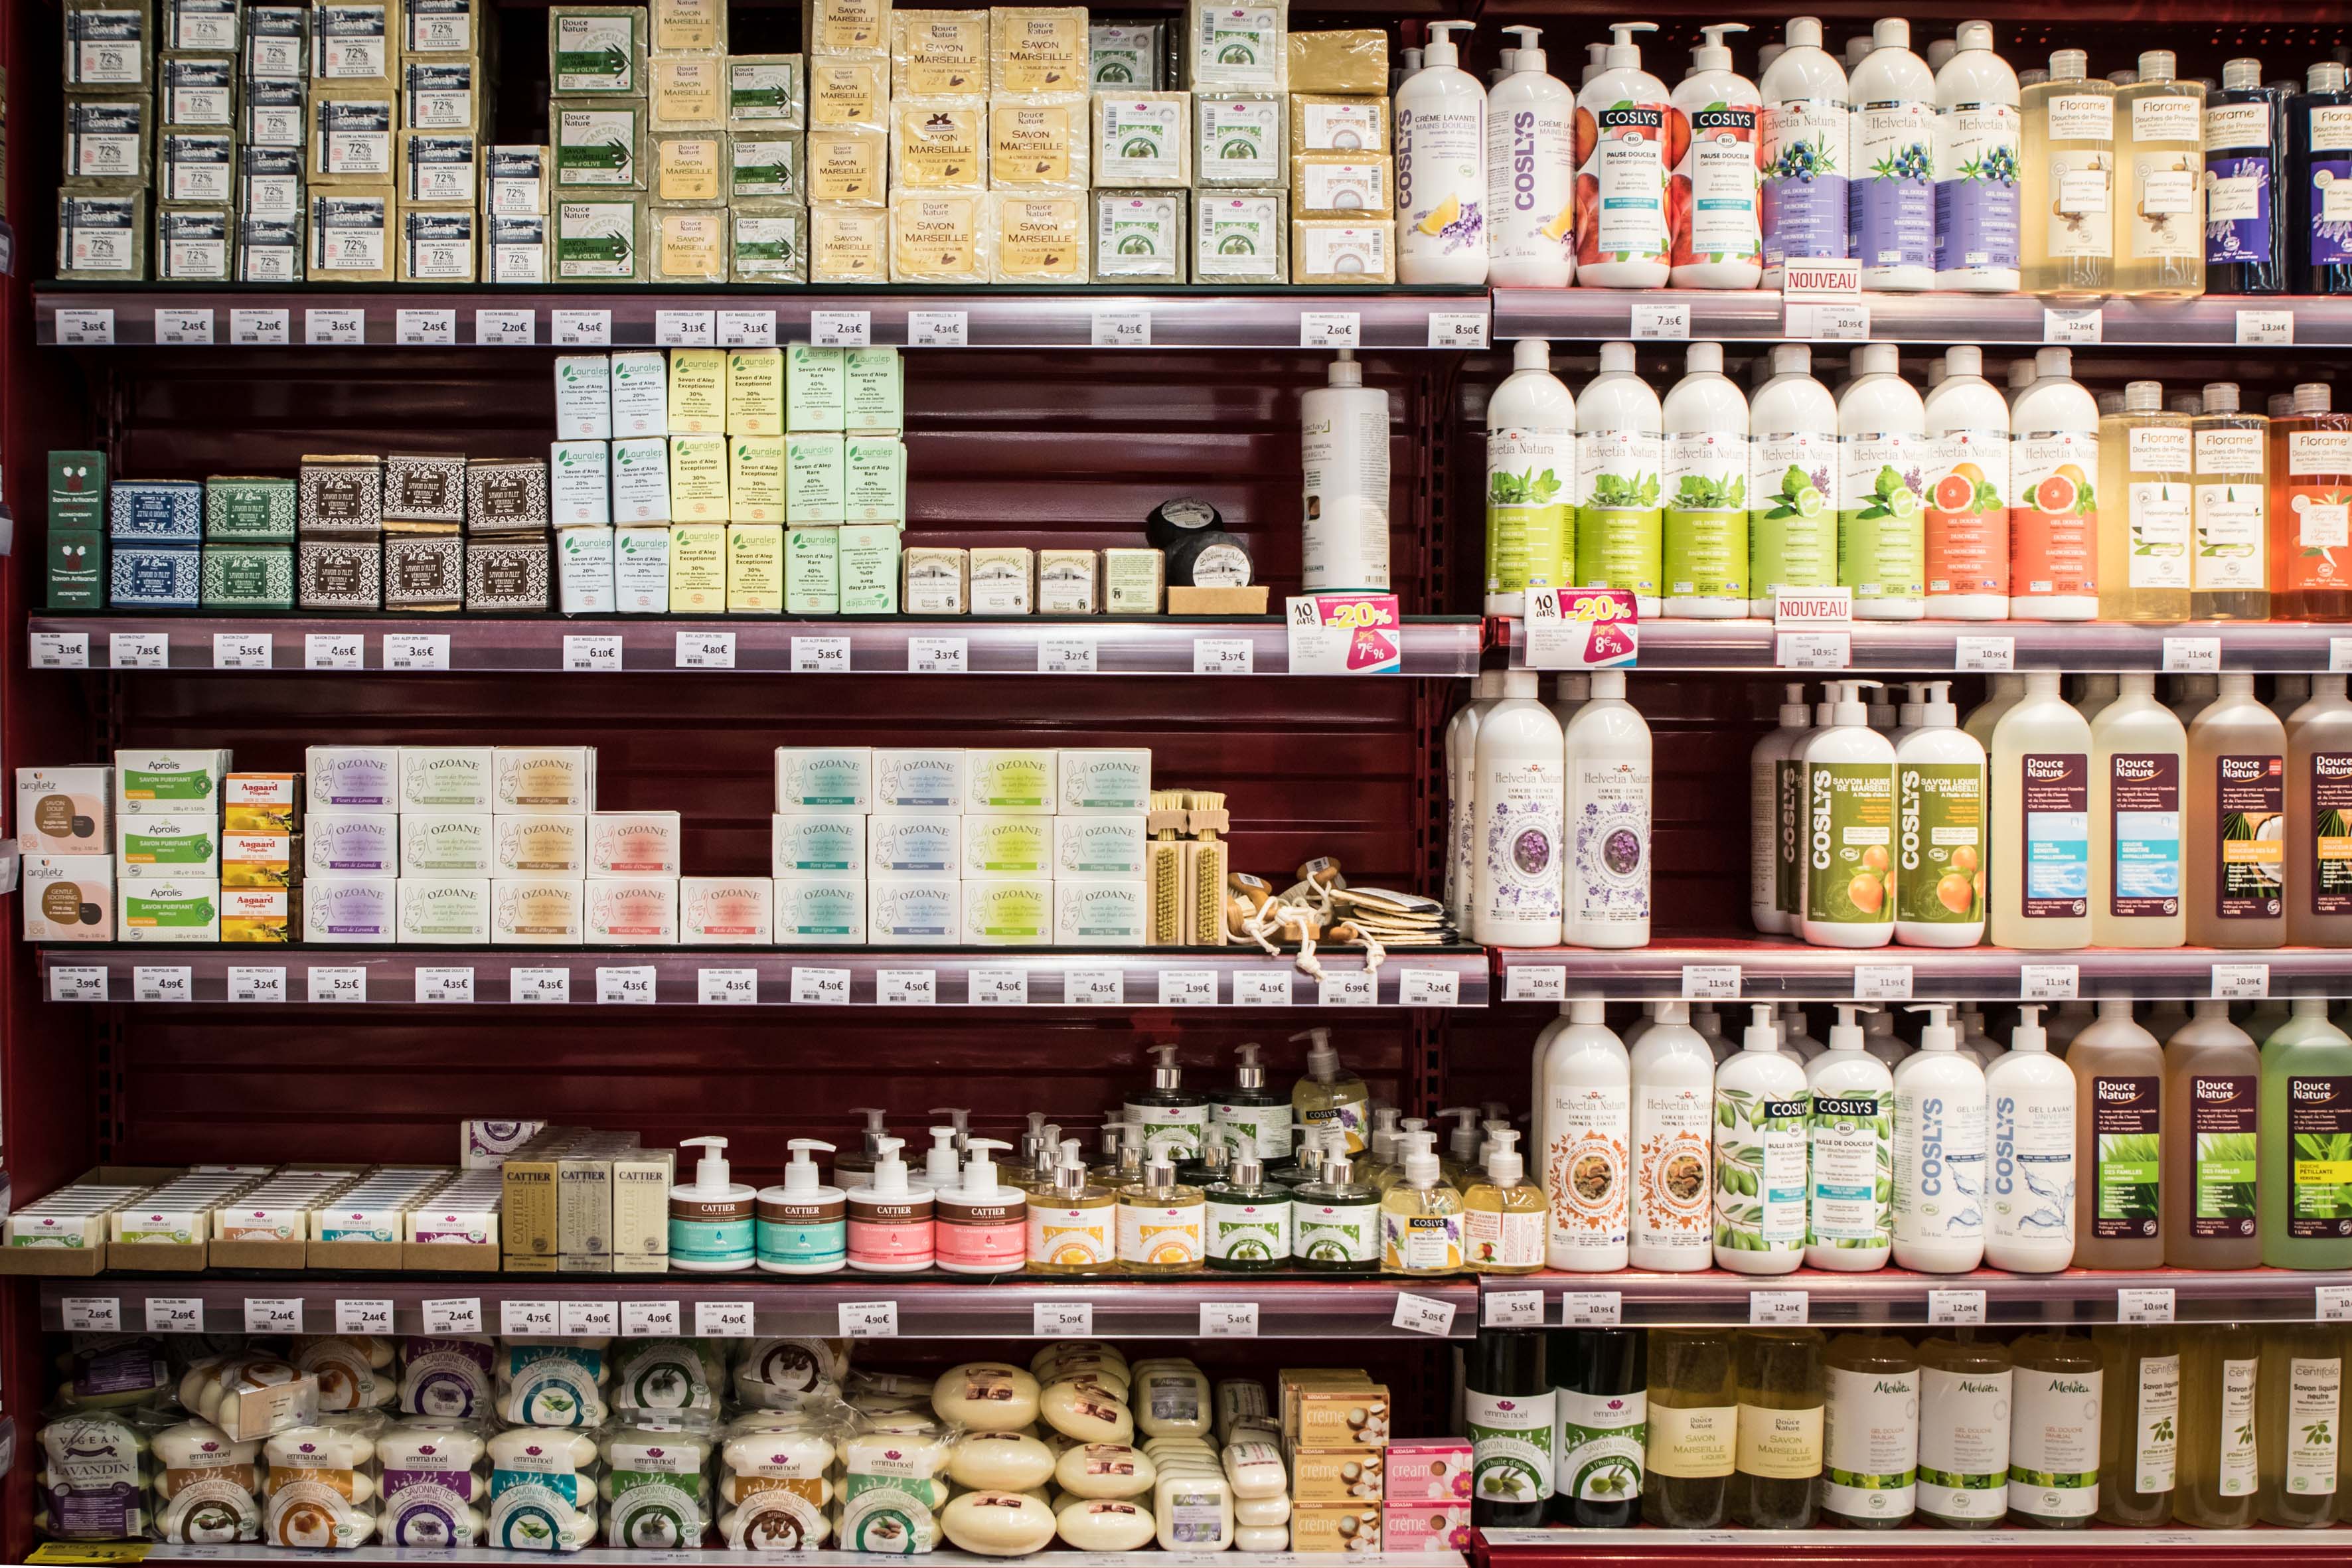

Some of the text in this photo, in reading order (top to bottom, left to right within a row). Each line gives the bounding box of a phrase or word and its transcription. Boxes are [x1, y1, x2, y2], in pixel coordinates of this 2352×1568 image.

[914, 55, 977, 64] MARSEILLE
[1010, 52, 1073, 60] MARSEILLE
[2060, 101, 2106, 112] Florame
[2144, 102, 2191, 112] Florame
[1415, 114, 1441, 123] CRÈME
[1606, 112, 1658, 125] COSLYS
[1699, 113, 1751, 127] COSLYS
[2209, 110, 2254, 122] Florame
[1804, 116, 1837, 127] Natura
[345, 240, 367, 251] 72%
[433, 251, 454, 260] 72%
[1788, 272, 1857, 289] NOUVEAU
[1658, 316, 1681, 325] 7,35€
[82, 322, 106, 331] 3,65€
[182, 321, 205, 330] 2,45€
[257, 321, 280, 330] 2,20€
[332, 321, 356, 330] 3,65€
[423, 322, 446, 331] 2,45€
[503, 323, 526, 331] 2,20€
[578, 323, 601, 331] 4,54€
[682, 323, 706, 332] 3,13€
[838, 324, 861, 333] 2,63€
[1328, 325, 1351, 334] 2,60€
[1456, 325, 1479, 334] 8,50€
[572, 367, 609, 376] Lauralep
[627, 363, 662, 372] Lauralep
[1535, 595, 1553, 610] 10
[1295, 603, 1312, 617] 10
[1536, 609, 1555, 617] ans
[1565, 595, 1632, 622] -20%
[1780, 602, 1847, 618] NOUVEAU
[1325, 602, 1393, 629] -20%
[58, 645, 82, 653] 3,19€
[136, 646, 159, 655] 7,85€
[240, 646, 264, 655] 5,55€
[410, 647, 433, 656] 3,65€
[591, 648, 614, 657] 6,10€
[702, 645, 726, 653] 4,80€
[1221, 652, 1245, 661] 3,57€
[148, 761, 180, 770] Aprolis
[337, 759, 388, 771] OZOANE
[429, 759, 480, 771] OZOANE
[809, 759, 860, 772] OZOANE
[903, 759, 954, 772] OZOANE
[1089, 761, 1140, 773] OZOANE
[2028, 758, 2064, 768] Douce
[2116, 758, 2154, 768] Douce
[2223, 759, 2260, 769] Douce
[2028, 768, 2064, 777] Nature
[2116, 768, 2154, 777] Nature
[2223, 769, 2260, 778] Nature
[242, 783, 277, 792] Aagaard
[1813, 770, 1832, 870] COSLYS
[1902, 771, 1920, 870] COSLYS
[149, 825, 181, 834] Aprolis
[239, 840, 275, 850] Aagaard
[77, 979, 100, 988] 3,99€
[159, 979, 183, 988] 4,99€
[254, 980, 277, 988] 3,24€
[443, 979, 467, 988] 4,35€
[538, 980, 563, 988] 4,35€
[623, 981, 647, 990] 4,35€
[819, 980, 843, 990] 4,50€
[905, 982, 929, 990] 4,50€
[996, 982, 1020, 990] 4,50€
[1186, 984, 1210, 992] 1,99€
[1260, 983, 1284, 992] 4,19€
[1345, 983, 1369, 992] 6,99€
[2099, 1081, 2136, 1091] Douce
[2197, 1080, 2234, 1090] Douce
[2099, 1091, 2136, 1099] Nature
[2197, 1090, 2234, 1099] Nature
[1820, 1100, 1872, 1114] COSLYS
[1921, 1098, 1942, 1196] COSLYS
[1996, 1097, 2014, 1195] COSLYS
[507, 1172, 550, 1181] CATTIER
[562, 1171, 605, 1180] CATTIER
[619, 1171, 663, 1180] CATTIER
[702, 1204, 735, 1212] CATTIER
[785, 1207, 819, 1215] CATTIER
[1414, 1219, 1444, 1227] COSLYS
[88, 1308, 112, 1320] 2,69€
[171, 1310, 195, 1319] 2,69€
[271, 1311, 294, 1320] 2,44€
[449, 1311, 473, 1320] 2,44€
[586, 1314, 609, 1322] 4,90€
[2294, 1383, 2338, 1393] Savon liquide
[59, 1434, 120, 1446] VIGEAN
[1770, 1435, 1802, 1444] SAVON
[54, 1464, 130, 1476] LAVANDIN
[1486, 1458, 1508, 1468] l'huile
[1509, 1458, 1530, 1473] d'olive
[1392, 1464, 1431, 1477] cream
[518, 1508, 532, 1516] aloe
[1389, 1518, 1426, 1531] crème
